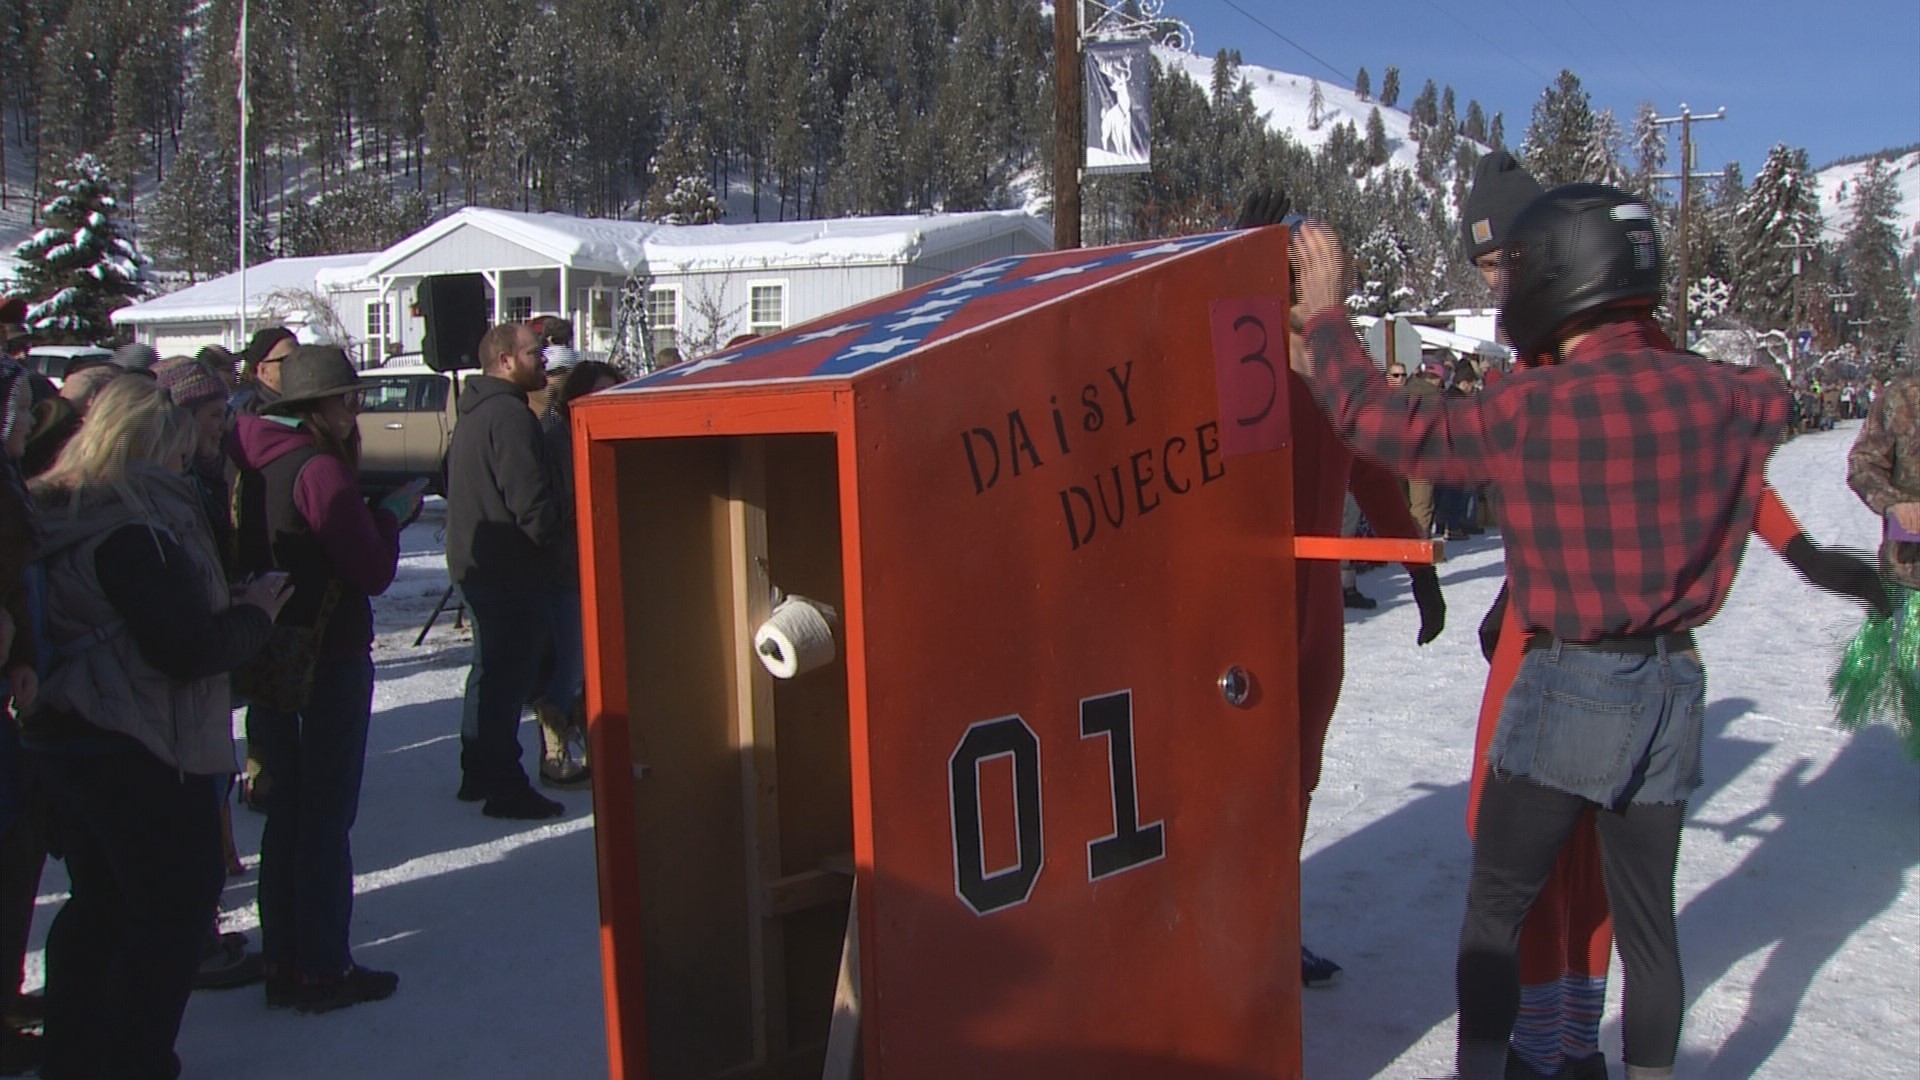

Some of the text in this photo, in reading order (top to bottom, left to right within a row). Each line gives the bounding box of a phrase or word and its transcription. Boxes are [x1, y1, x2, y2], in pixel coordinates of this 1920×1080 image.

[1233, 314, 1277, 427] 3
[1058, 421, 1225, 551] DUECE
[948, 688, 1166, 916] 01
